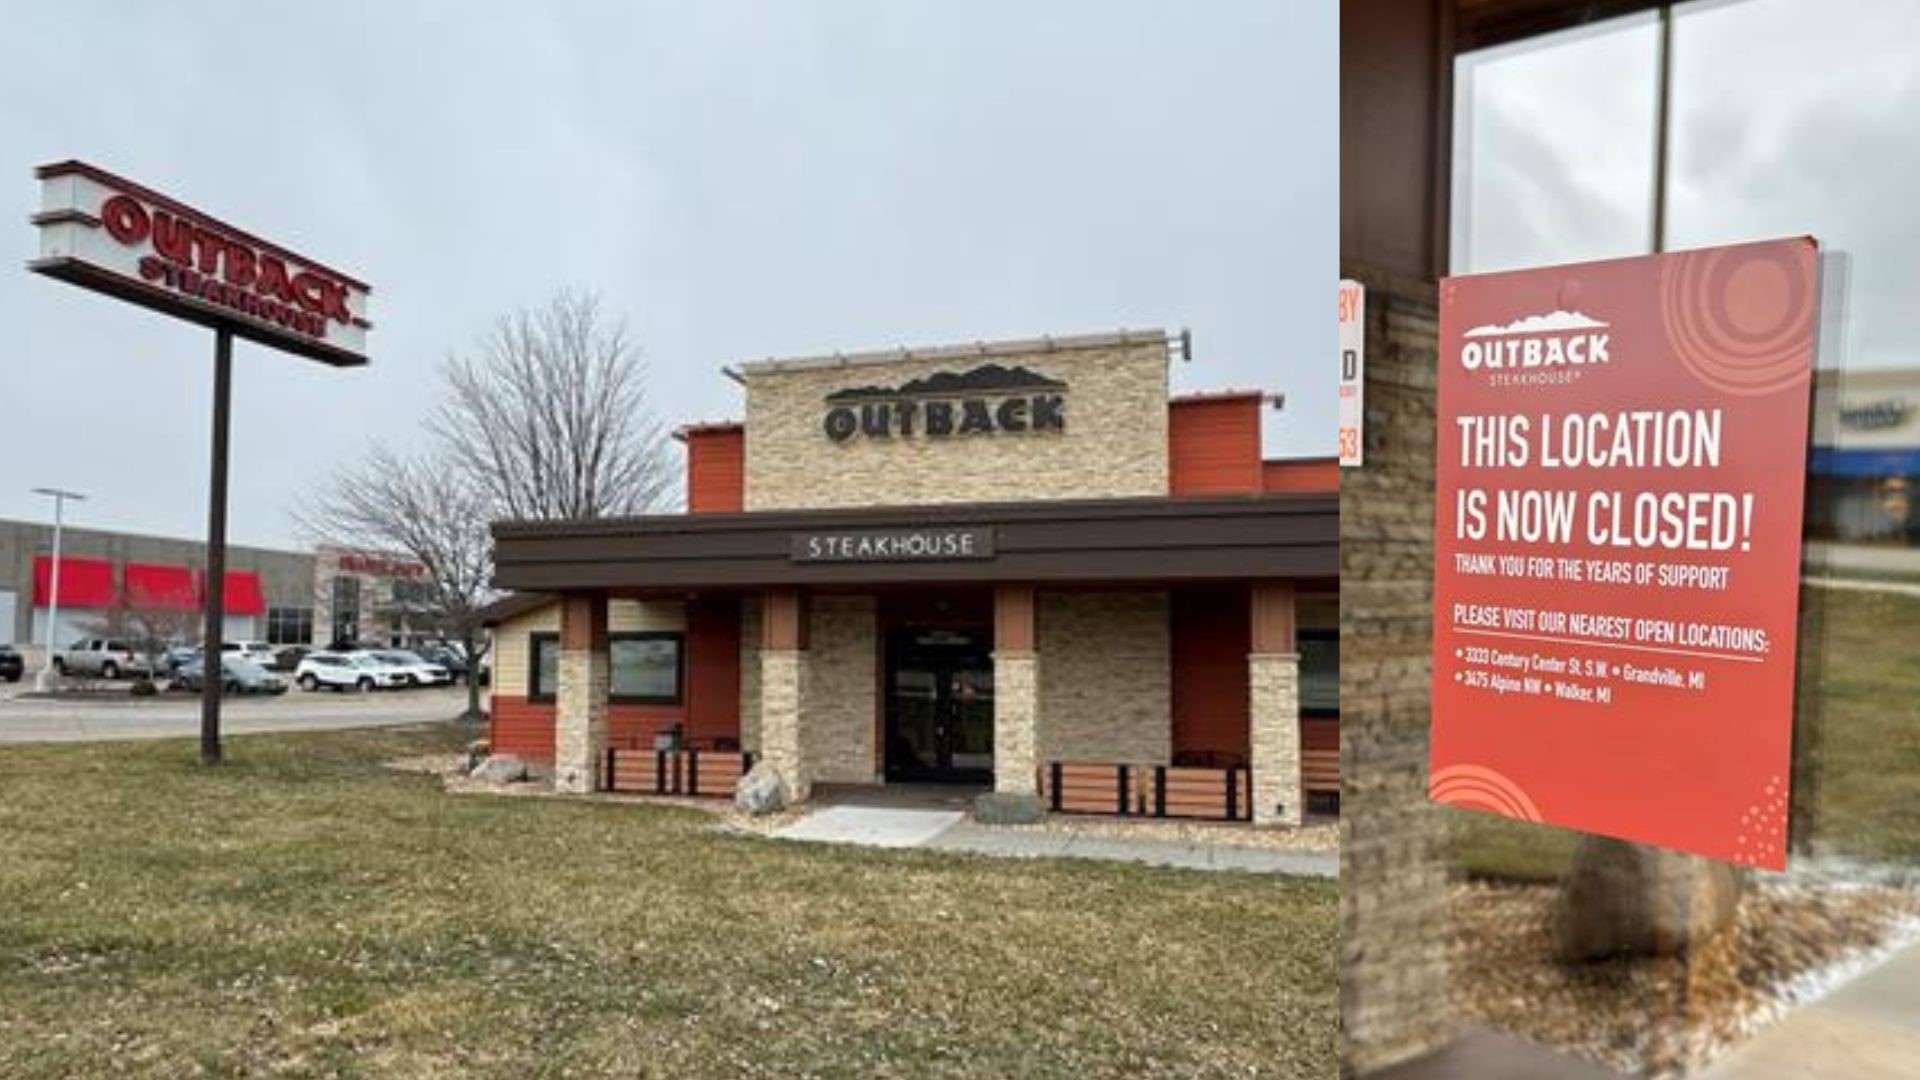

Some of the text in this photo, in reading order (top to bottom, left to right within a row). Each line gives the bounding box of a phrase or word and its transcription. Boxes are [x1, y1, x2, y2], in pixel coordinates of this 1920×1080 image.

[101, 194, 351, 325] OUTBACK
[1461, 334, 1609, 370] OUTBACK
[823, 394, 1065, 443] OUTBACK
[1457, 409, 1721, 468] THIS LOCATION
[1456, 489, 1753, 552] IS NOW CLOSED!
[809, 533, 974, 557] STEAKHOUSE
[1455, 553, 1729, 590] THANK YOU FOR THE YEARS OF SUPPORT
[1454, 603, 1770, 653] PLEASE VISIT OUR NEAREST OPEN LOCATIONS:
[1596, 686, 1611, 704] MI
[1688, 671, 1705, 690] MI
